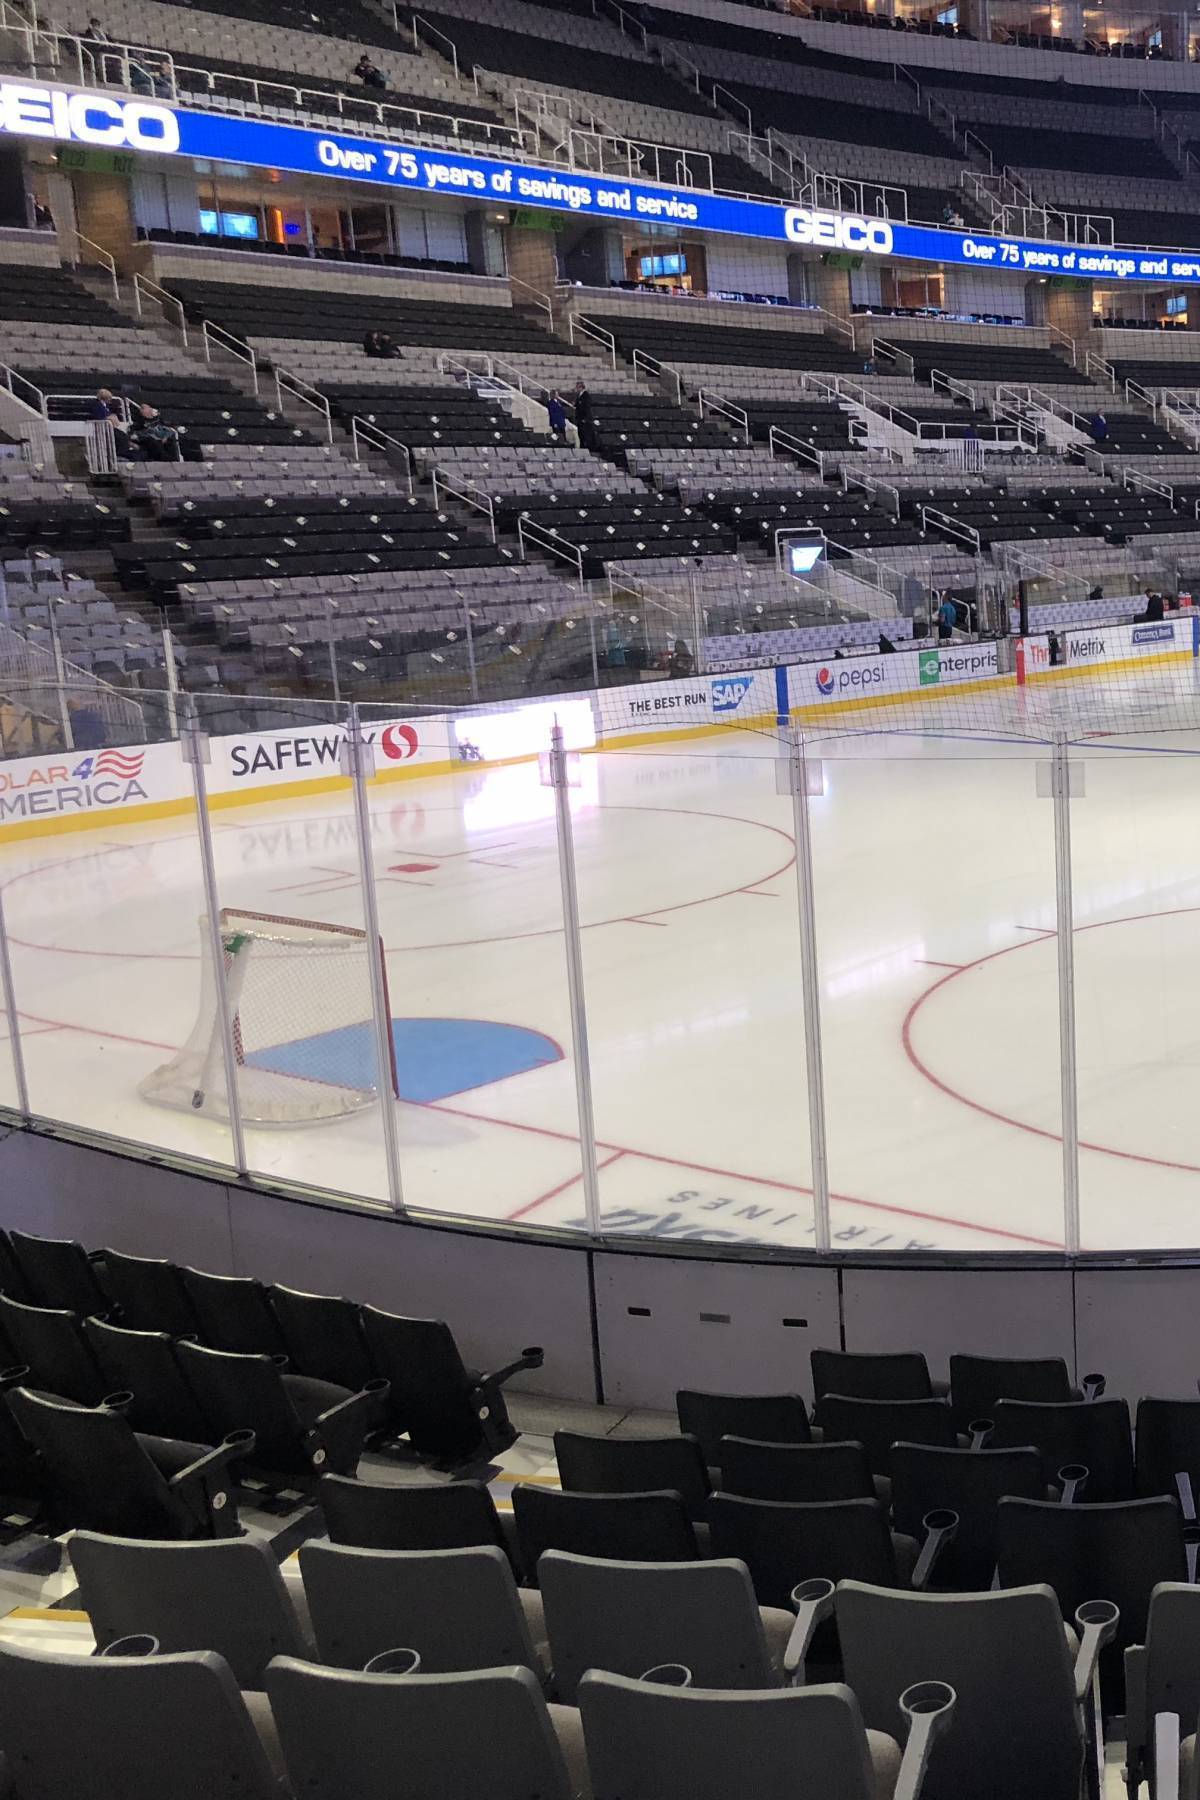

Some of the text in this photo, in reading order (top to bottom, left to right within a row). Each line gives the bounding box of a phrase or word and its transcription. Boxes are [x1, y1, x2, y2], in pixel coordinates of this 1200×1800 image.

[0, 84, 180, 152] EICO
[319, 140, 698, 220] Over 75 years of savings and service
[784, 208, 893, 254] GEICO
[962, 239, 996, 260] Over
[1000, 243, 1019, 263] 75
[1023, 249, 1059, 268] years
[1062, 251, 1076, 268] of
[1079, 255, 1136, 276] savings
[1140, 258, 1168, 274] and
[925, 651, 997, 676] enterpris
[1030, 644, 1049, 663] Thr
[839, 663, 886, 692] pepsi
[629, 683, 746, 713] THE BEST RUN SAP
[0, 758, 94, 792] OLAR 4
[0, 780, 148, 820] MERICA
